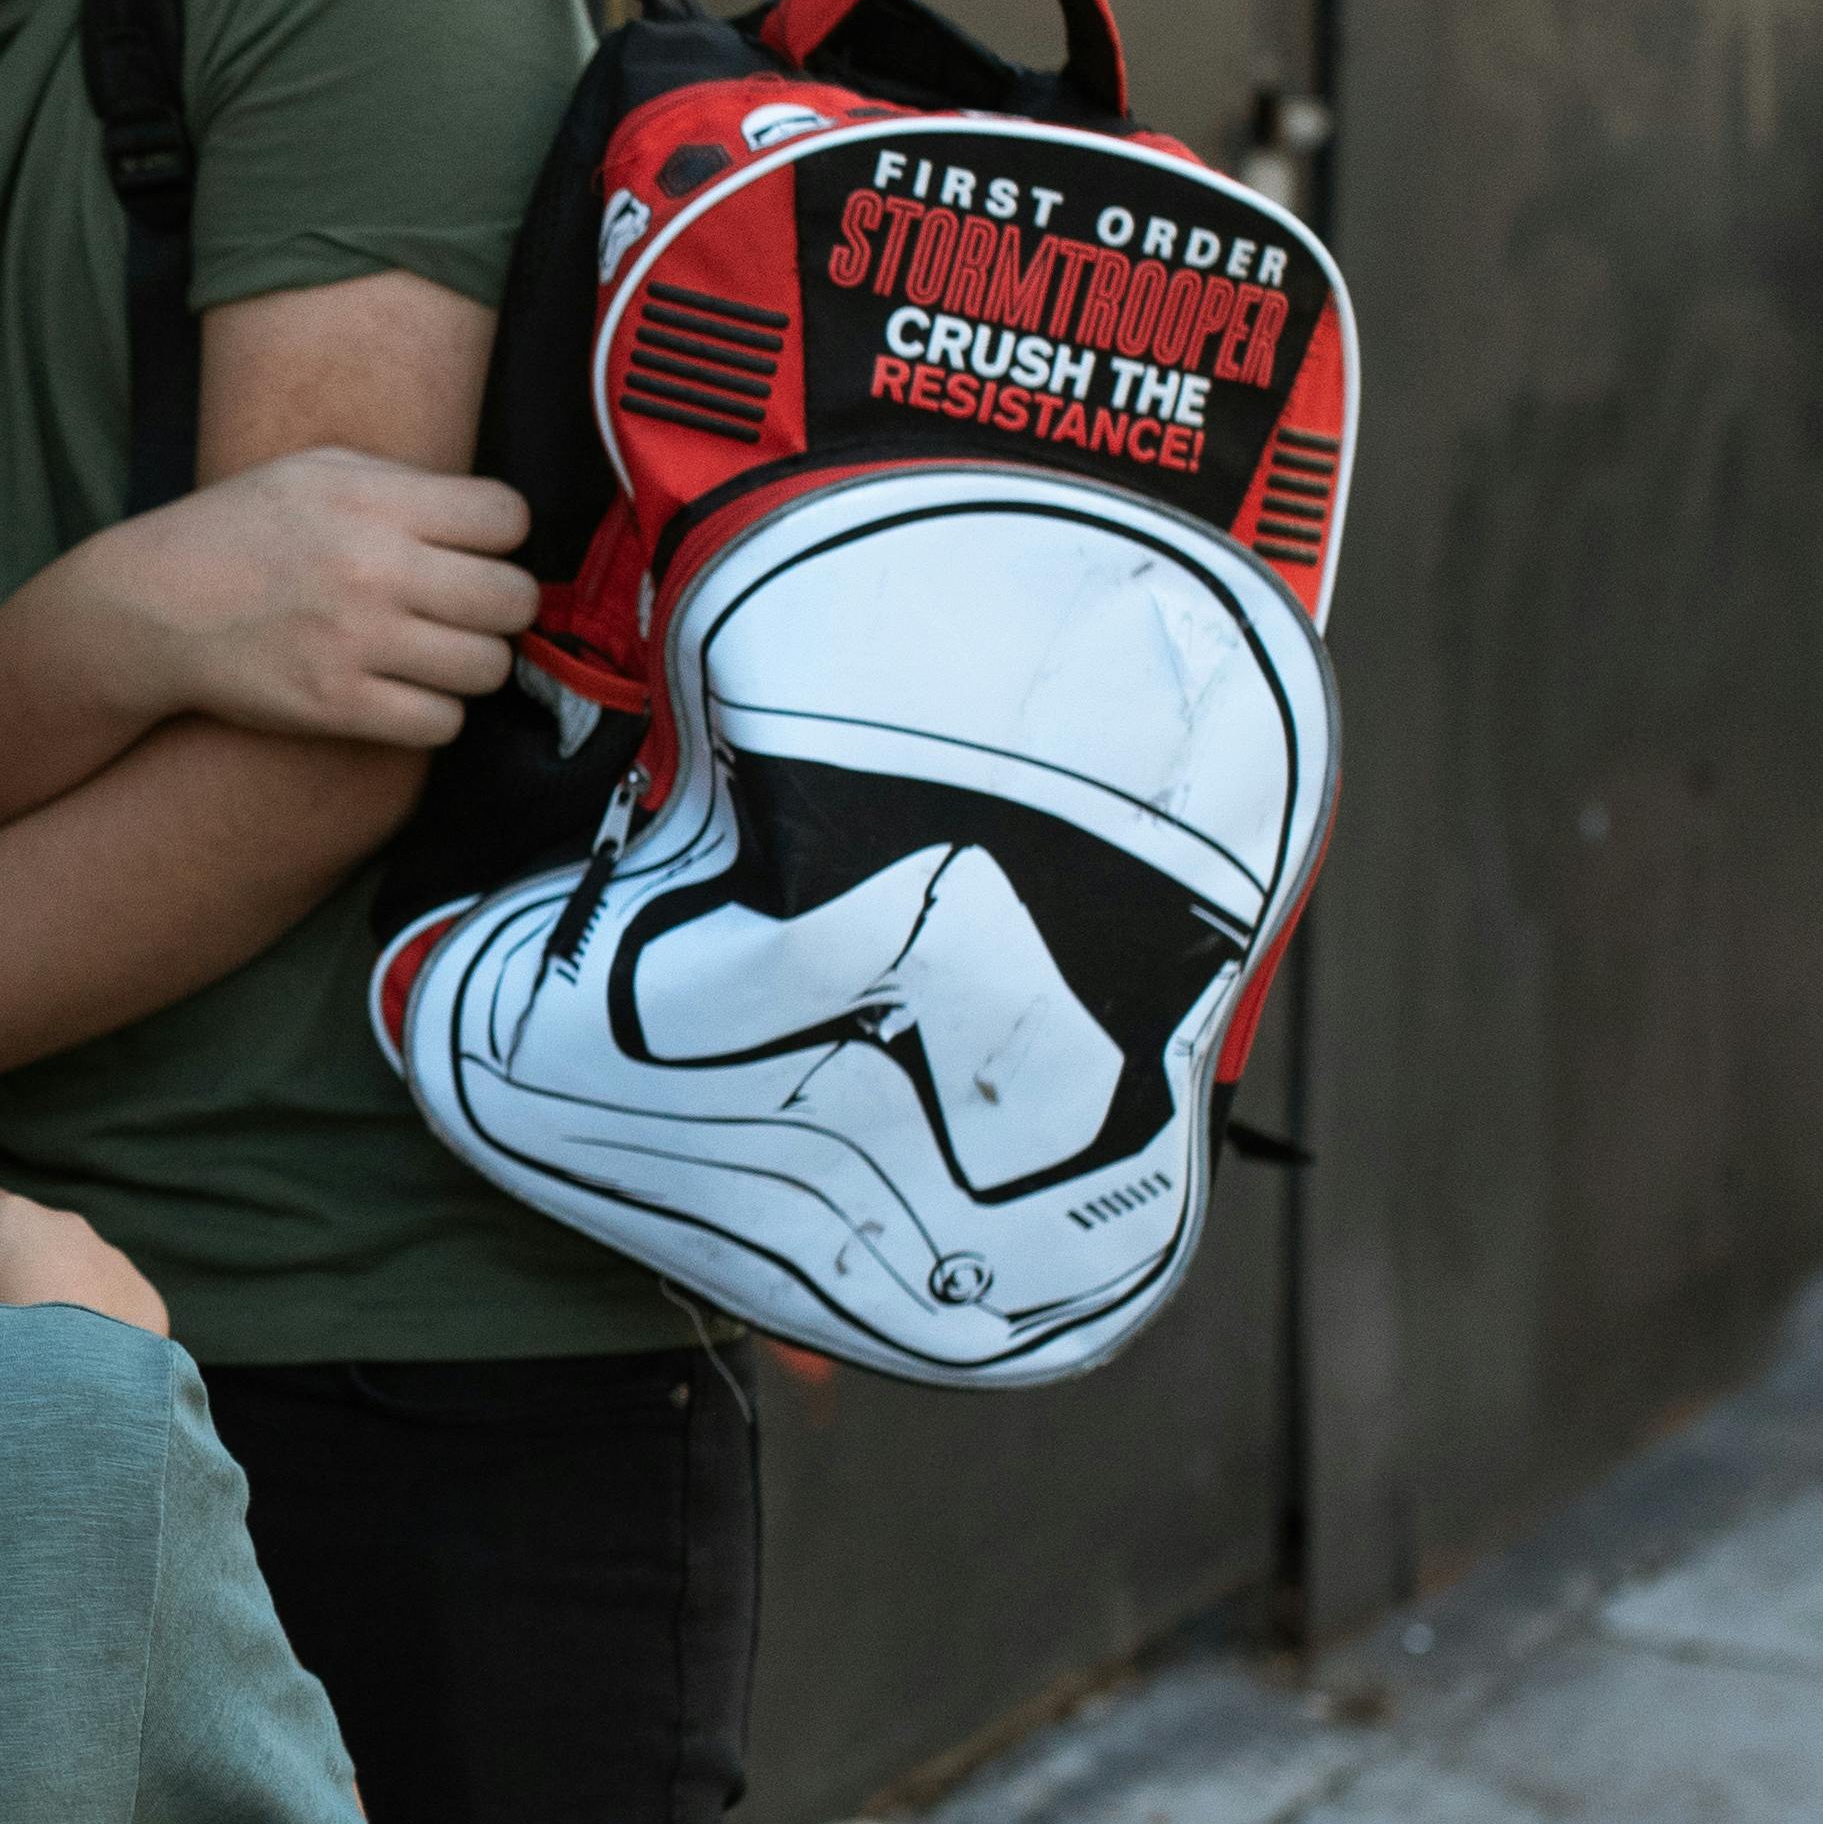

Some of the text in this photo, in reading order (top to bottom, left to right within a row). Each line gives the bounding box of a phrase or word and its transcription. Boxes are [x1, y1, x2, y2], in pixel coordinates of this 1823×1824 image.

[873, 148, 1289, 286] FIRST ORDER
[828, 187, 1290, 389] STORMTROOPER
[870, 354, 1206, 473] RESISTANCE!
[884, 305, 1212, 427] CRUSH THE
